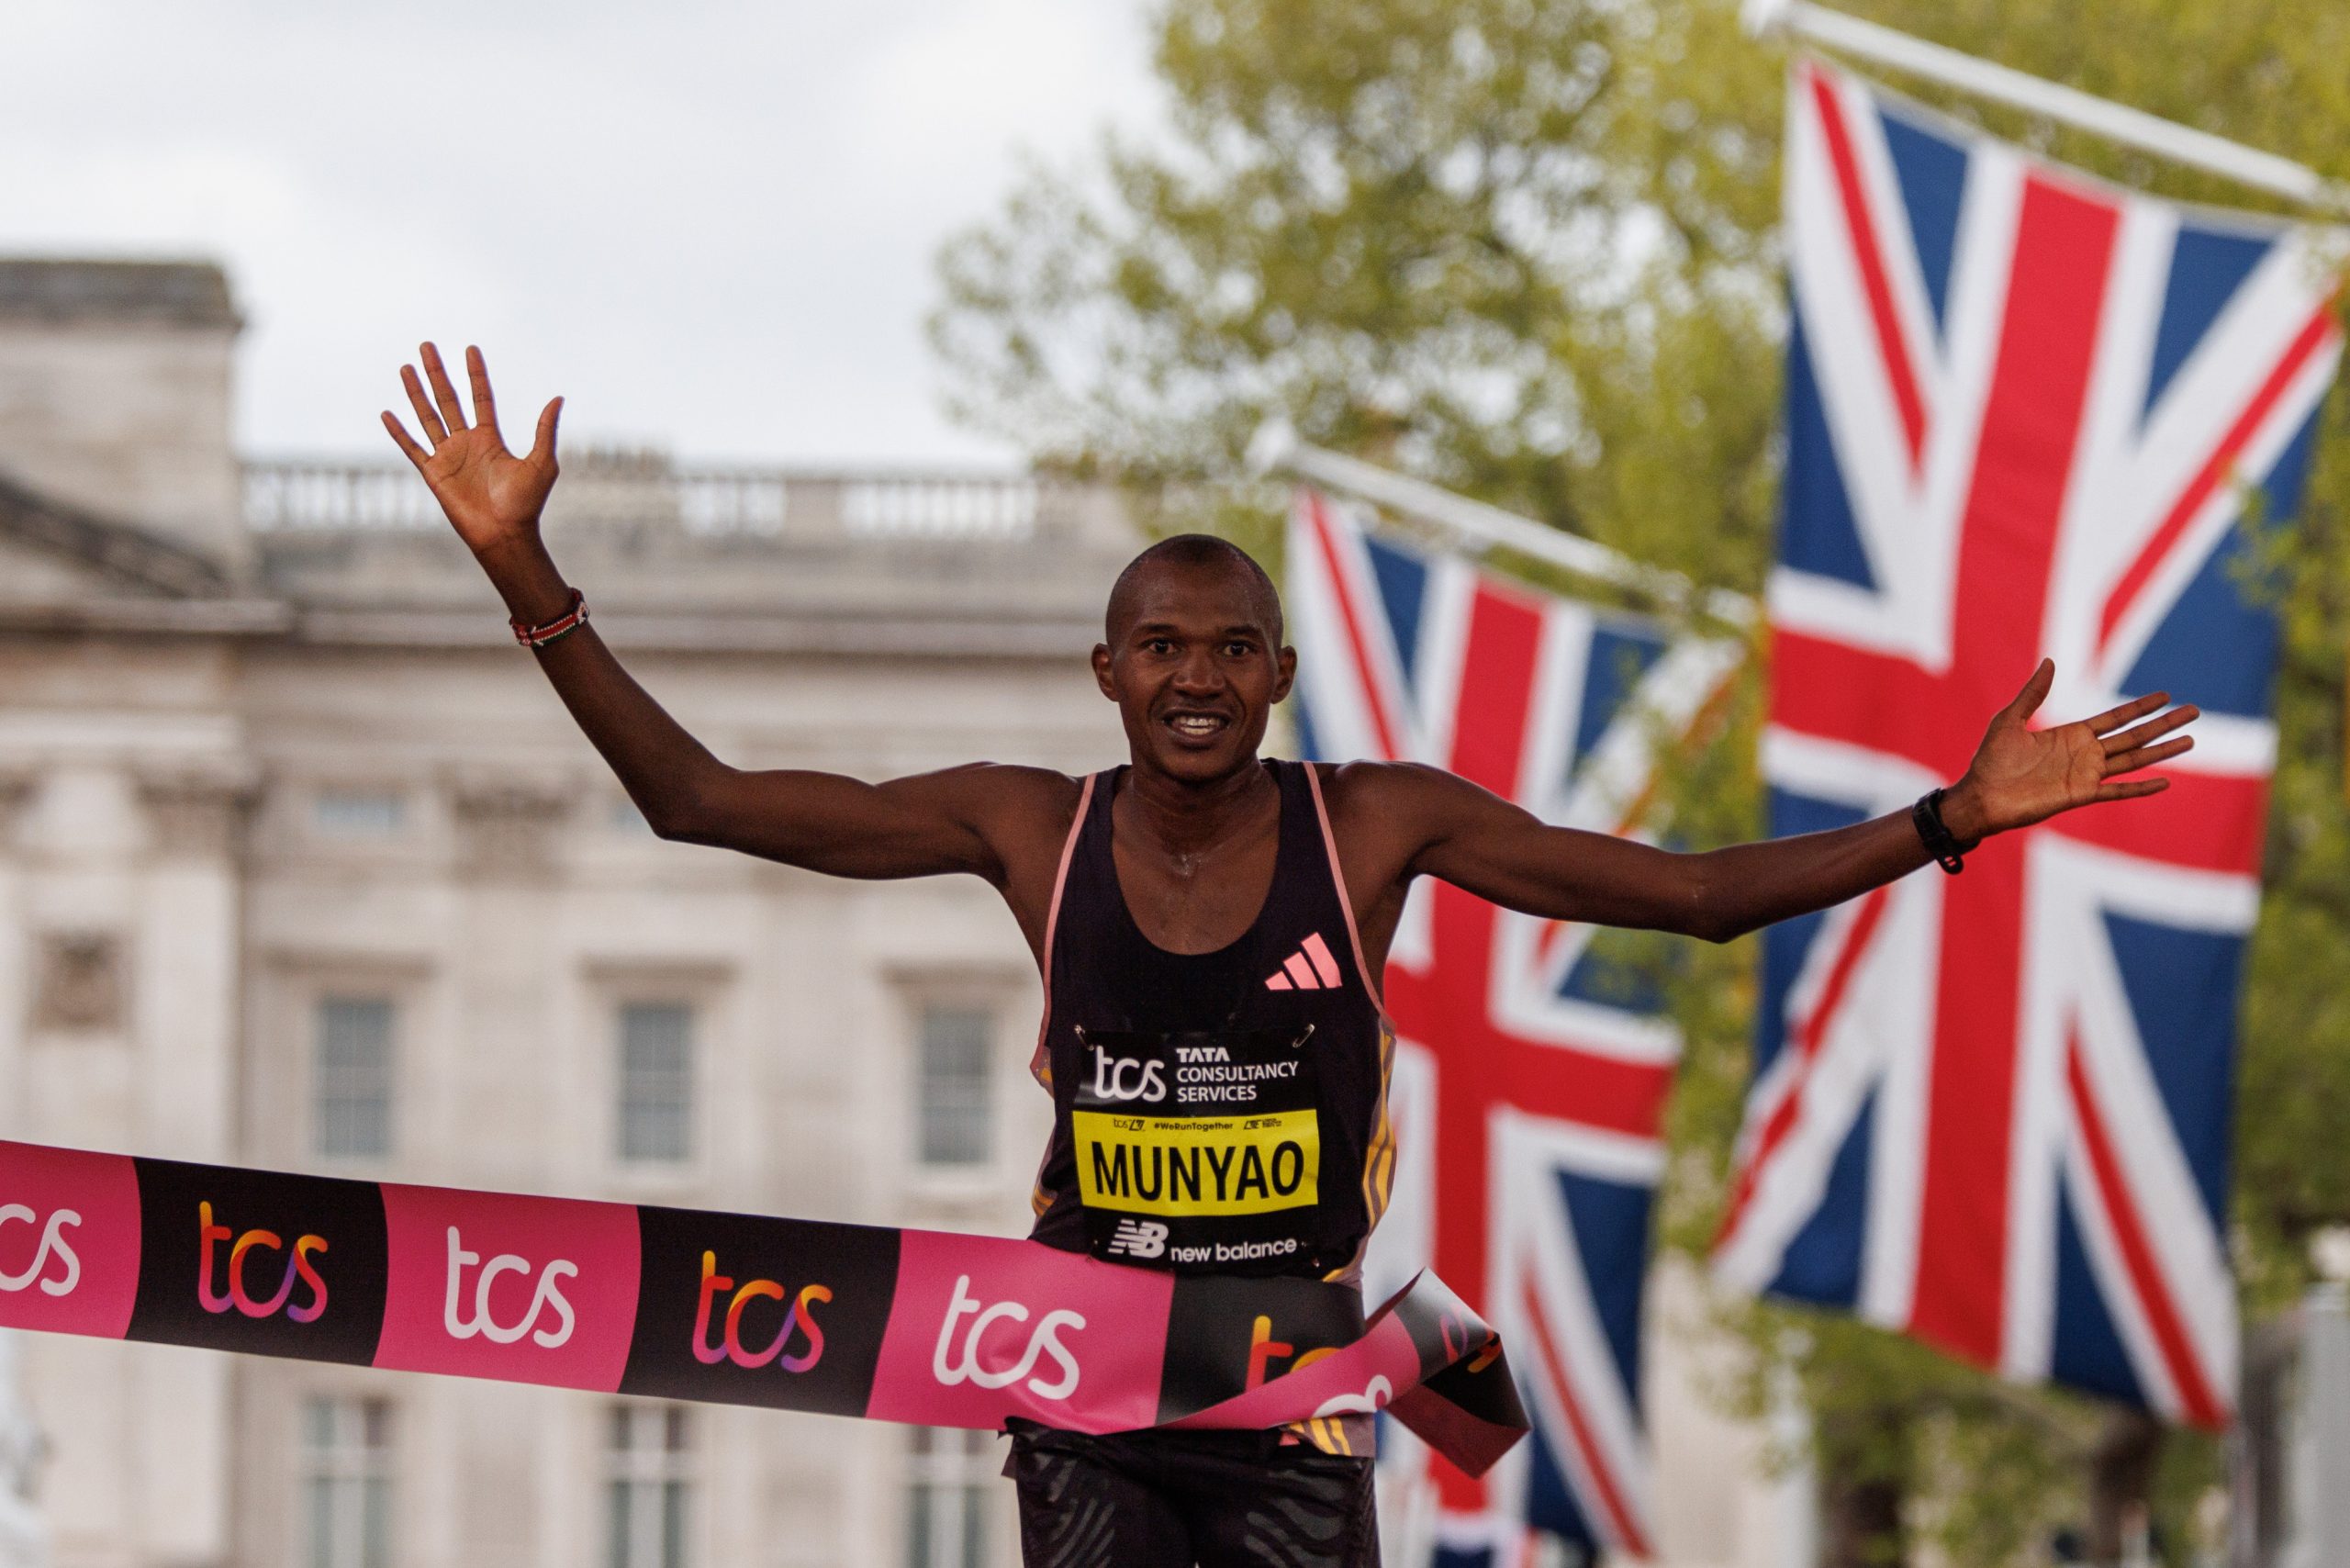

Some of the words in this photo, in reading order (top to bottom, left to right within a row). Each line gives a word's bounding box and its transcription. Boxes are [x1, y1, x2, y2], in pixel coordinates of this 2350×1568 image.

[1176, 1047, 1231, 1062] TATA
[1095, 1045, 1167, 1102] tcs
[1176, 1061, 1299, 1083] CONSULTANCY
[1177, 1085, 1257, 1102] SERVICES
[1154, 1122, 1234, 1132] #WeRunTogether
[1091, 1140, 1304, 1202] MUNYAO
[1170, 1246, 1212, 1262] new
[1216, 1238, 1297, 1261] balance
[0, 1204, 82, 1296] cs
[198, 1201, 328, 1323] tcs
[444, 1226, 578, 1349] tcs
[692, 1250, 833, 1373] tcs
[933, 1275, 1087, 1400] tcs
